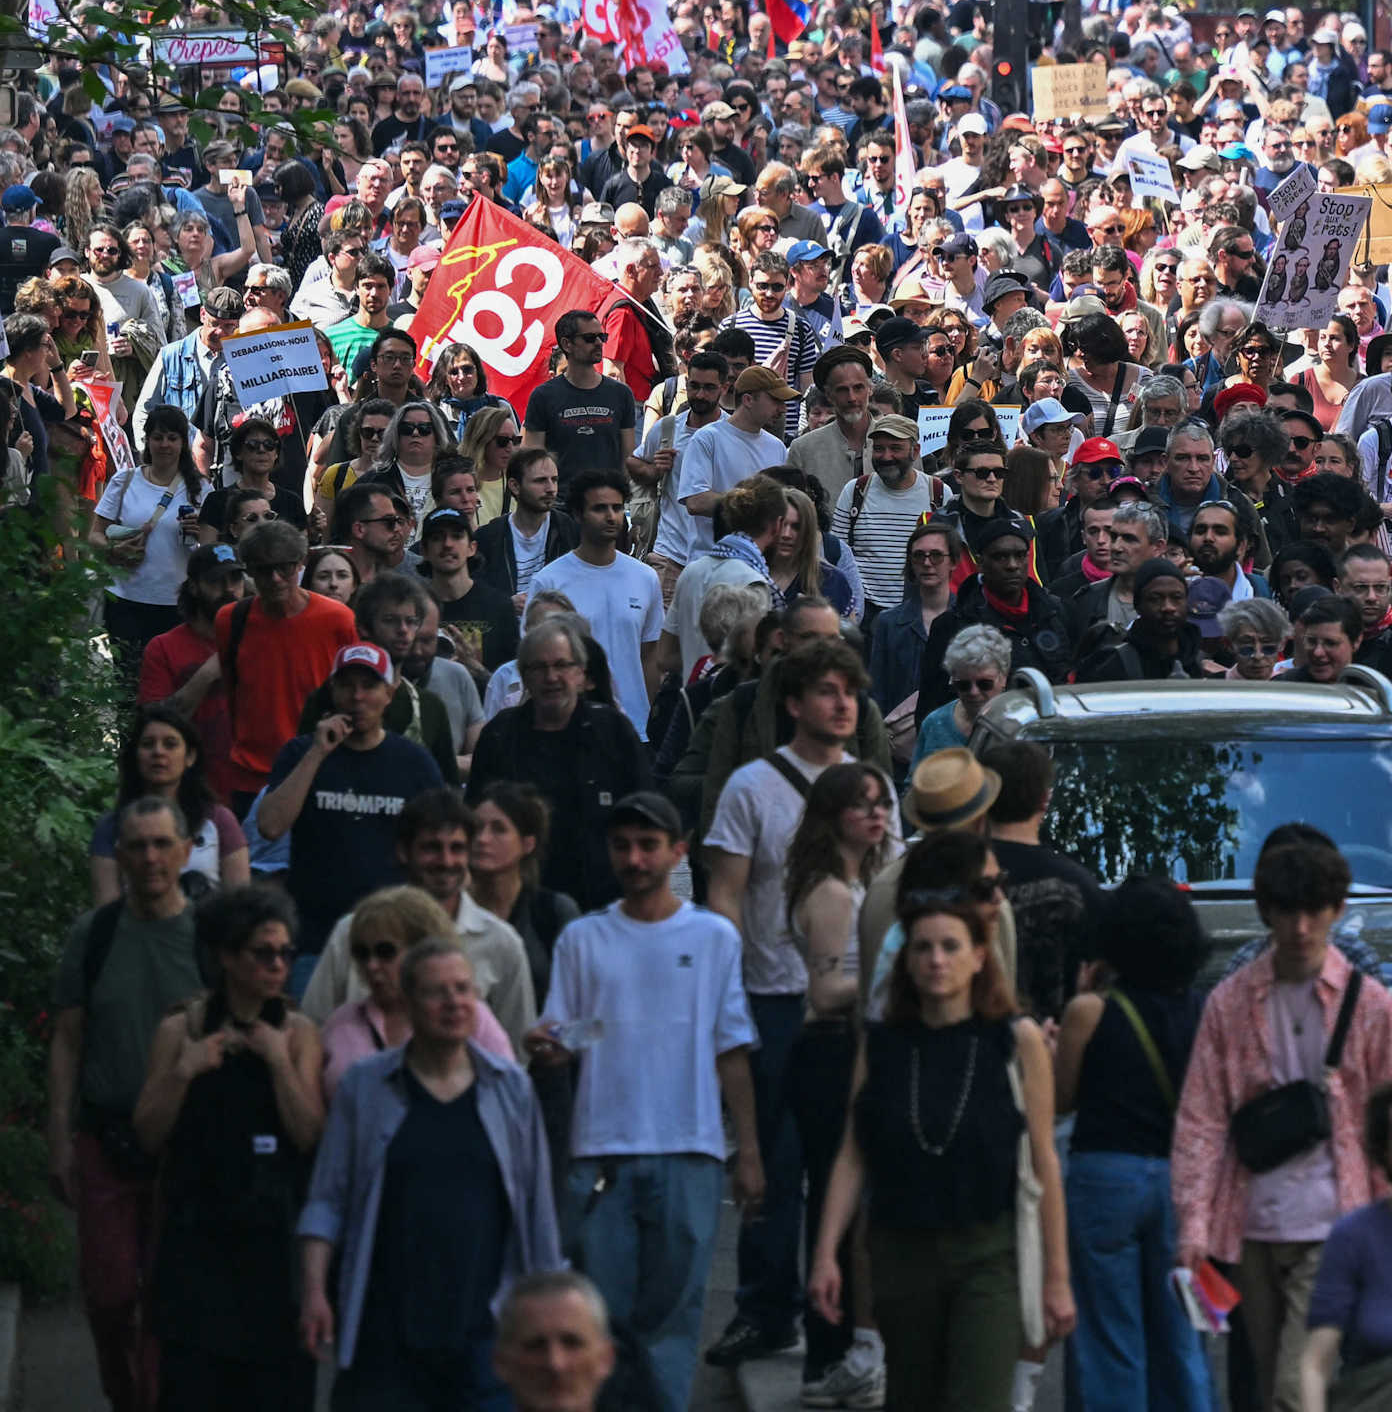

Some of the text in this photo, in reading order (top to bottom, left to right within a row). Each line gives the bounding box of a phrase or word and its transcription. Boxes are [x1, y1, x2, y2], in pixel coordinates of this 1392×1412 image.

[1271, 178, 1298, 205] Stop
[1319, 196, 1355, 219] Stop
[1320, 221, 1359, 238] rats!
[1324, 215, 1340, 224] aux
[231, 335, 310, 359] DEBARASSONS-NOUS
[269, 354, 284, 363] DES
[239, 364, 319, 390] MILLIARDAIRES
